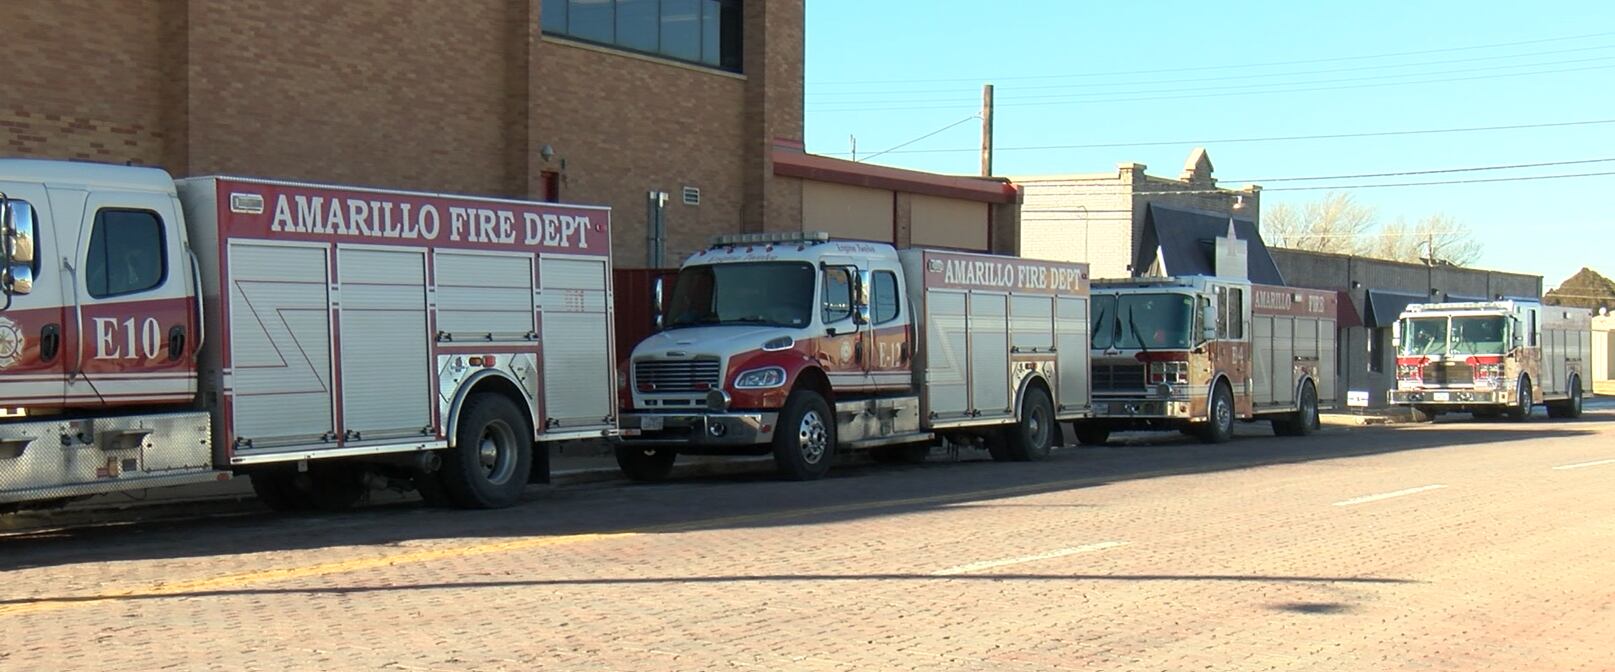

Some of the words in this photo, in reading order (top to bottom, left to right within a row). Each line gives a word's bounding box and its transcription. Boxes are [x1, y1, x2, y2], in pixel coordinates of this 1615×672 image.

[271, 194, 440, 239] AMARILLO
[450, 206, 516, 243] FIRE
[524, 212, 591, 248] DEPT
[944, 260, 1014, 287] AMARILLO
[1017, 265, 1048, 289] FIRE
[1050, 267, 1081, 290] DEPT
[1254, 290, 1291, 311] AMARILLO
[92, 316, 161, 359] E10
